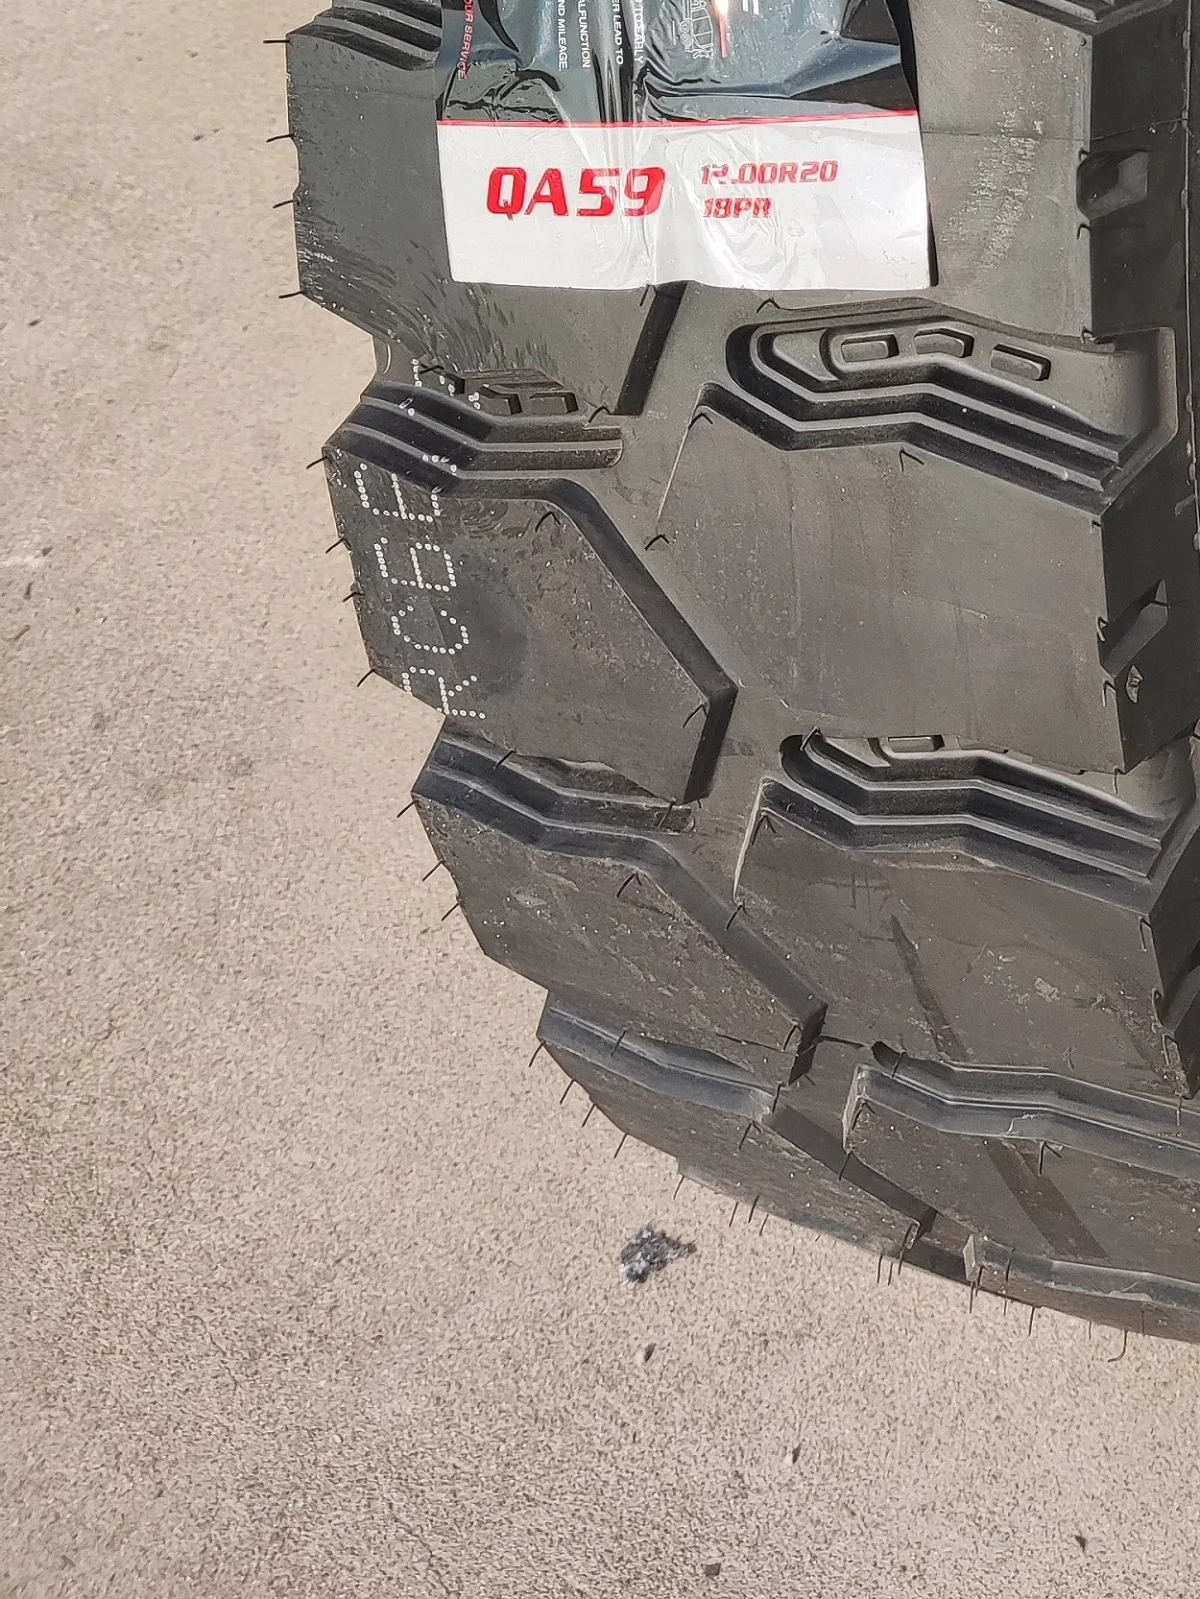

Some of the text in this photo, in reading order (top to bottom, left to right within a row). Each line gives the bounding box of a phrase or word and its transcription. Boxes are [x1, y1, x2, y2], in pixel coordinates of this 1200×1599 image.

[632, 6, 643, 21] TO
[613, 14, 622, 45] LEAD
[633, 24, 644, 63] EARLY
[558, 18, 567, 71] MILEAGE.
[615, 48, 624, 64] TO
[701, 160, 839, 185] 12.00R20
[486, 166, 667, 220] QA59
[702, 197, 773, 219] 18PR
